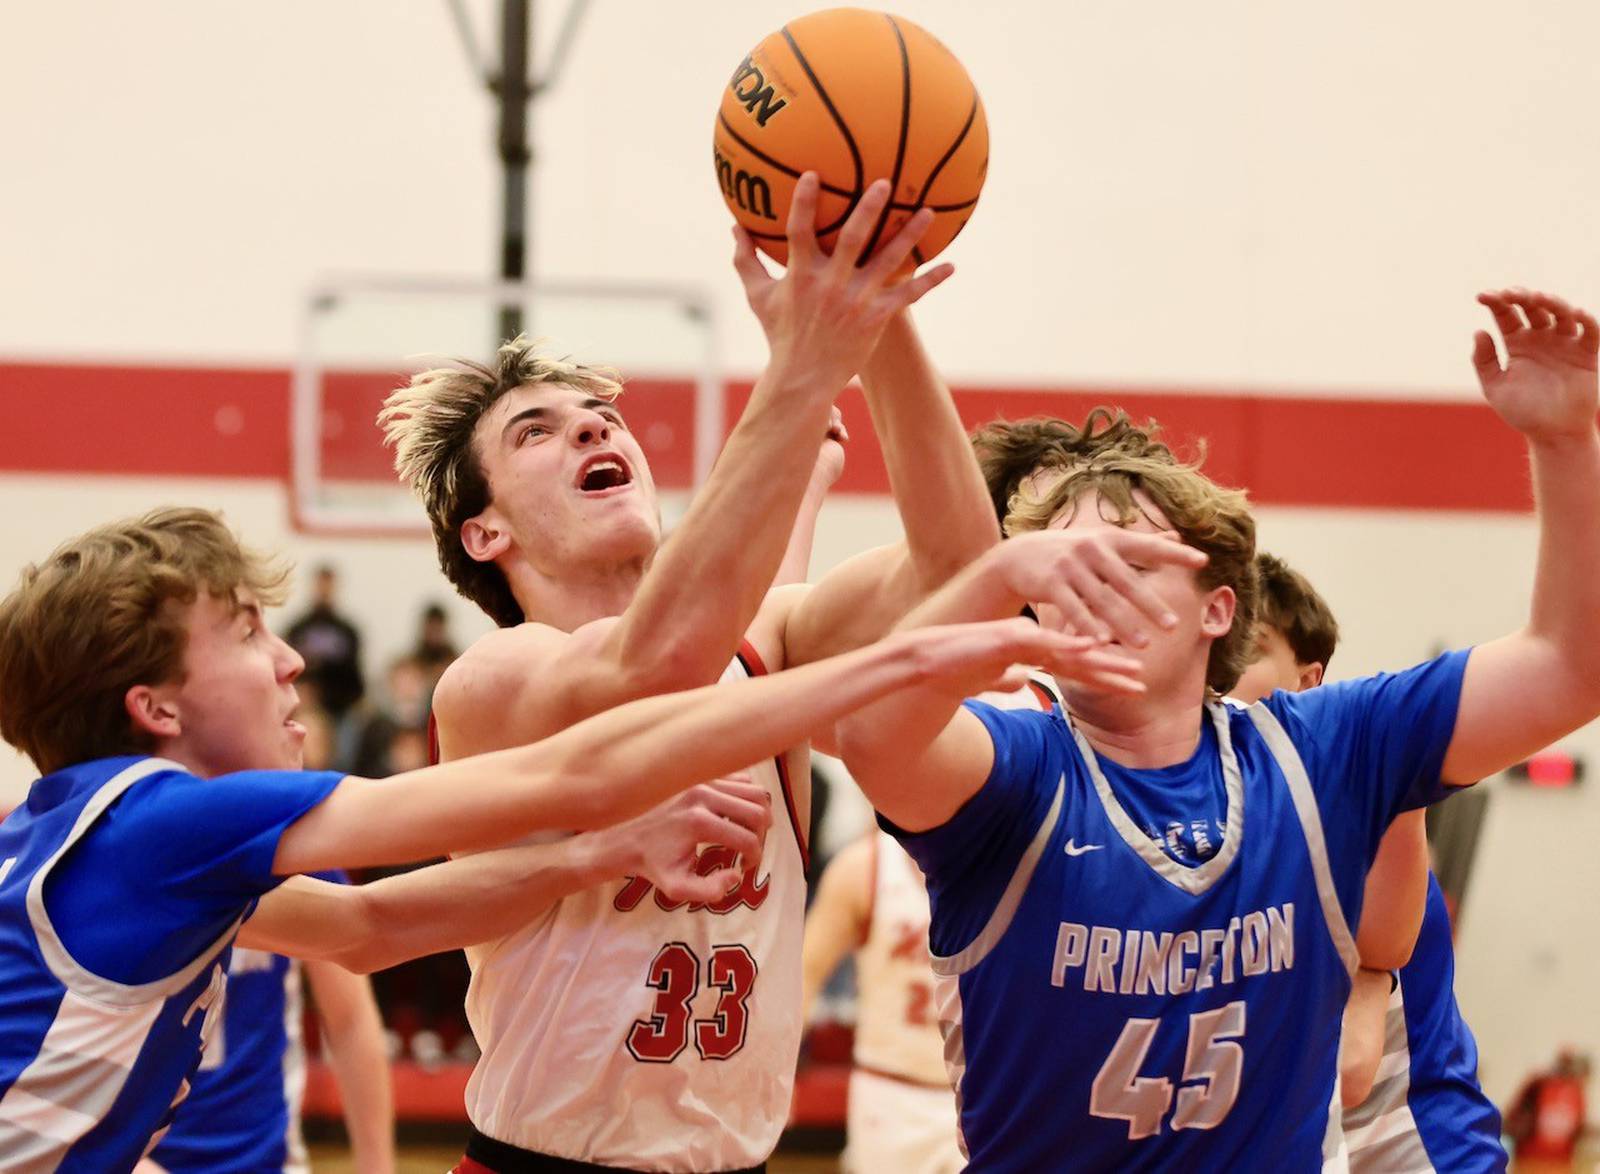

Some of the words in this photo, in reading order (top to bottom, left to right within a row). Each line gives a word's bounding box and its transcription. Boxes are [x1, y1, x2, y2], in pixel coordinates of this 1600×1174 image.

[732, 54, 787, 128] NCA
[626, 942, 758, 1063] 33
[1051, 902, 1295, 996] PRINCETON
[1089, 1000, 1246, 1140] 45
